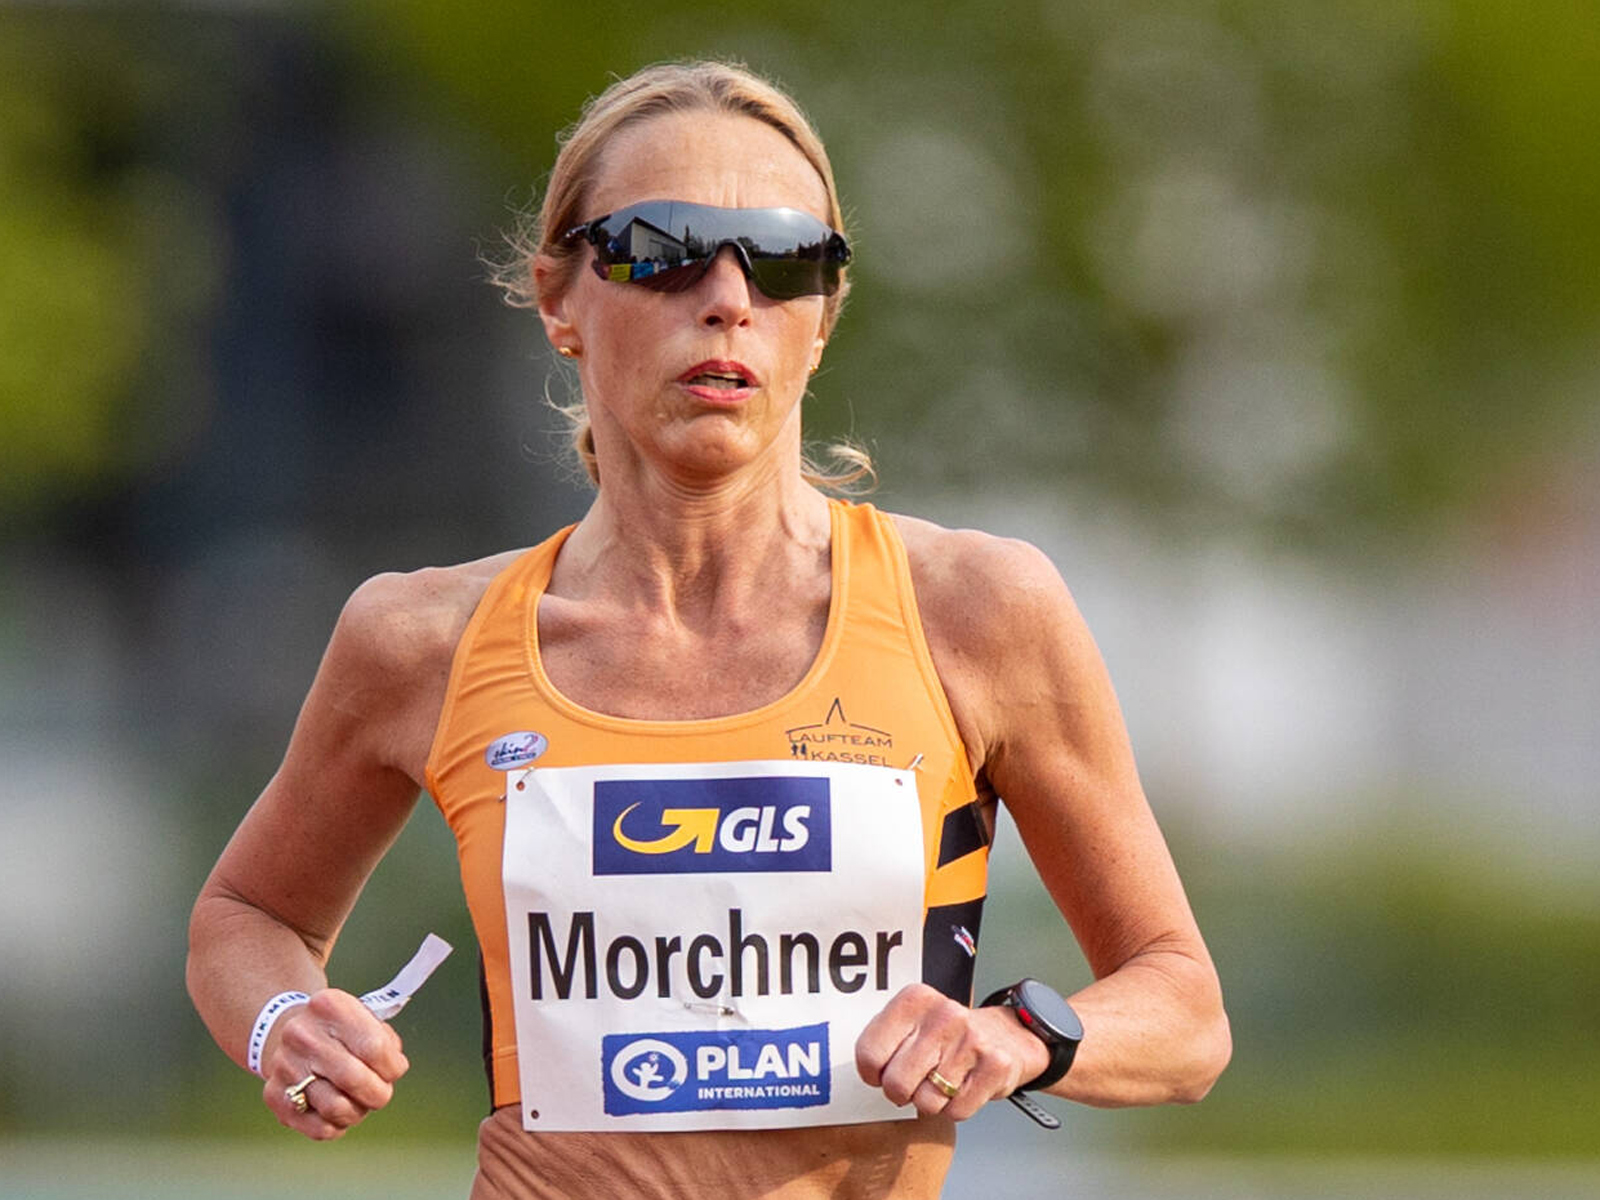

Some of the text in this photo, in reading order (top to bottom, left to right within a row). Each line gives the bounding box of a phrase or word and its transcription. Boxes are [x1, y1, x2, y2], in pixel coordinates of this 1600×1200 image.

[788, 732, 893, 748] LAUFTEAM
[811, 750, 893, 768] KASSEL
[719, 805, 811, 854] GLS
[527, 908, 903, 1000] Morchner
[696, 1042, 821, 1080] PLAN
[697, 1083, 821, 1100] INTERNATIONAL
